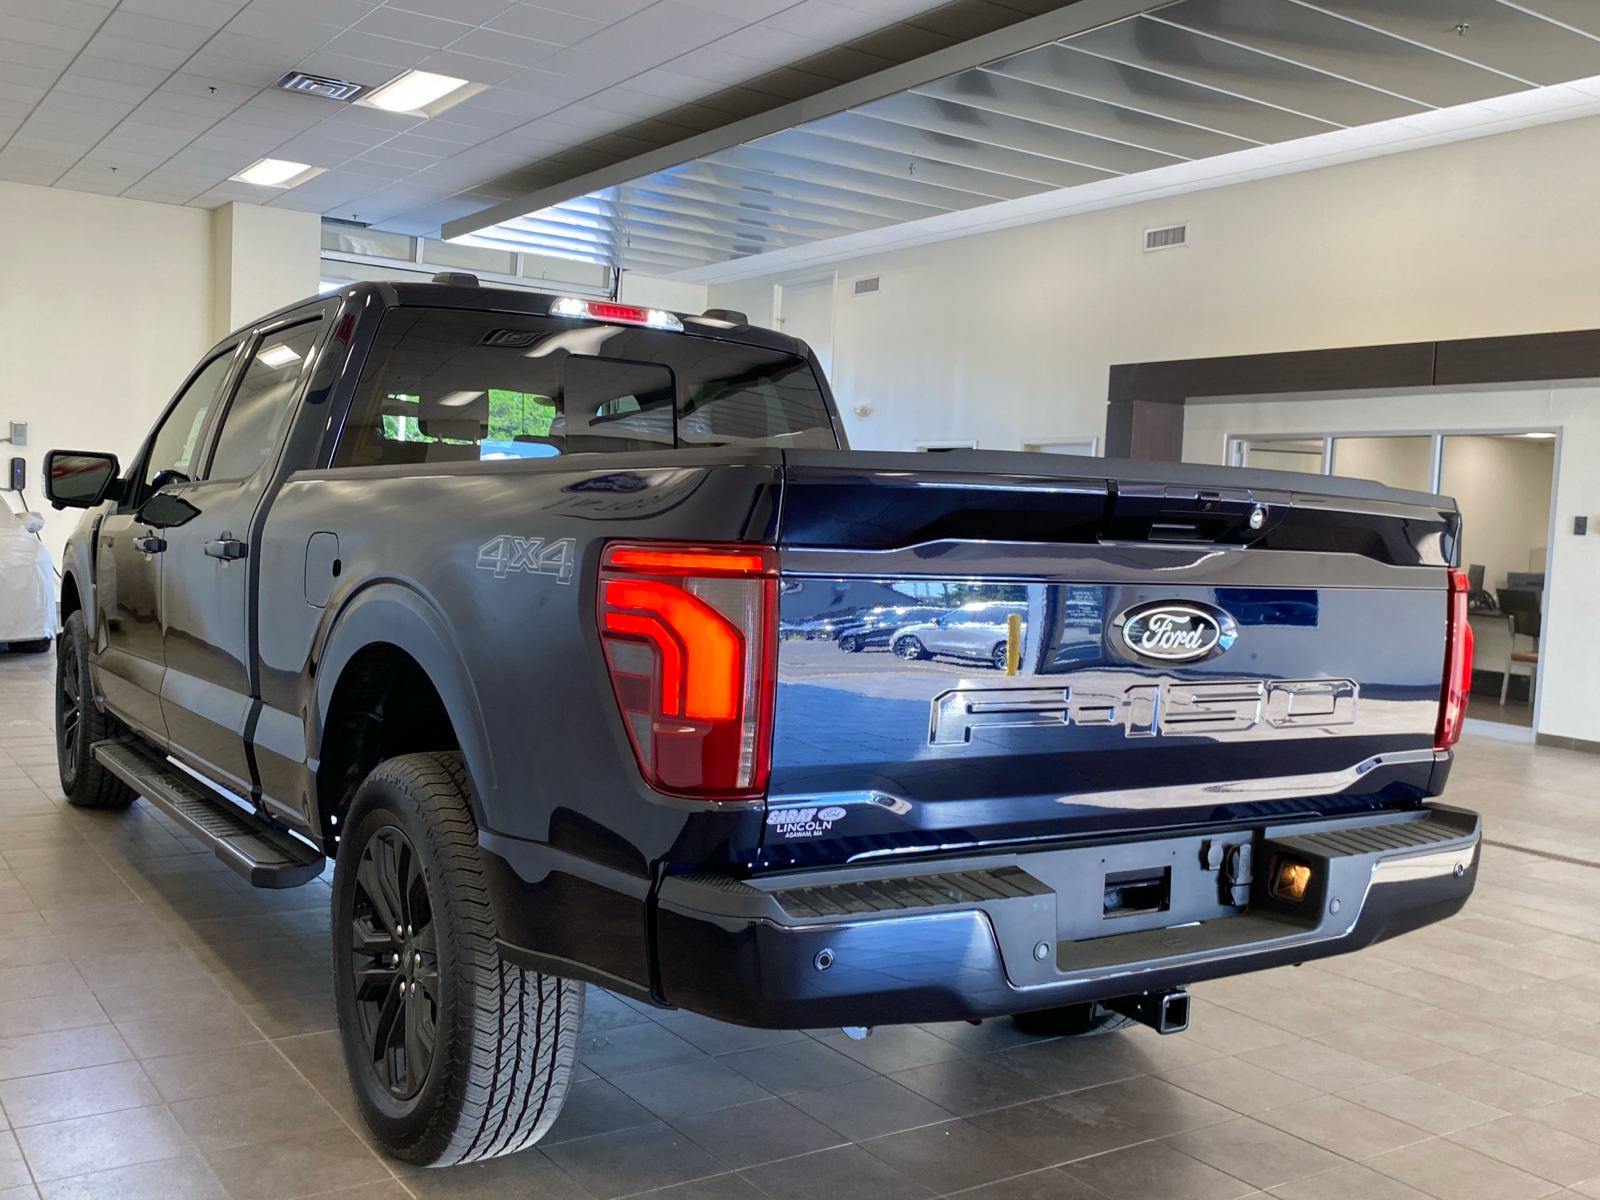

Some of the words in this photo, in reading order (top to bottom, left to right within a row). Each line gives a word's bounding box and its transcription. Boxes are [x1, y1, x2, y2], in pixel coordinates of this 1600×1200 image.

[476, 535, 576, 585] 4X4
[1142, 613, 1205, 649] Ford
[928, 677, 1360, 747] F-150
[766, 808, 818, 825] SARAT
[776, 821, 832, 833] LINCOLN
